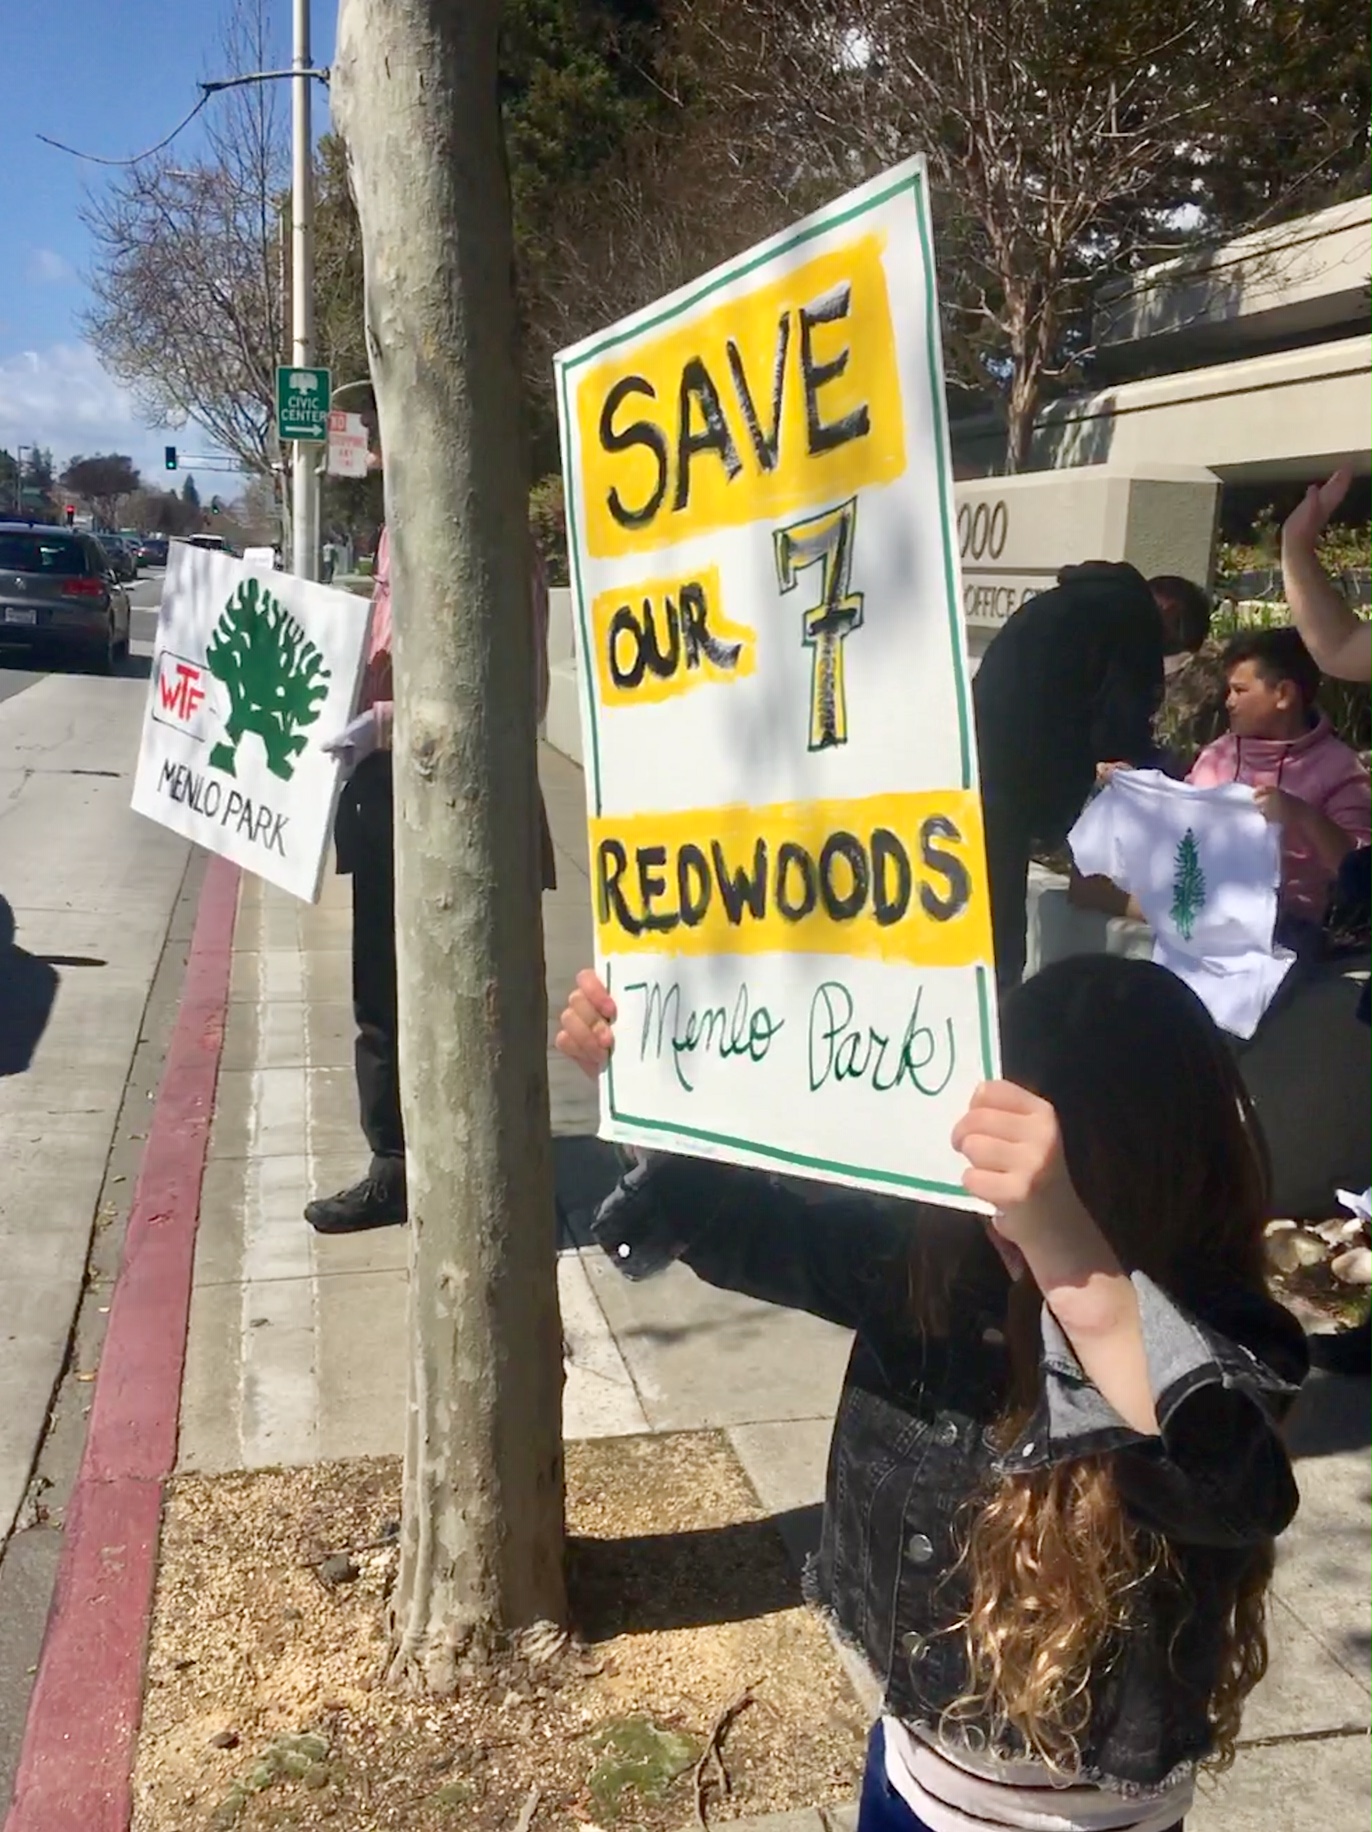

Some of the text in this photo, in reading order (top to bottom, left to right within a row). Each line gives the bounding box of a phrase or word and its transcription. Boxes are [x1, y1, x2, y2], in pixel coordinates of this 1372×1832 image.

[281, 408, 327, 422] CENTER
[288, 396, 320, 409] CIVIC
[600, 280, 870, 530] SAVE
[609, 496, 864, 752] OUR 7
[964, 584, 1016, 618] OFFICE
[160, 664, 205, 722] WTF
[157, 758, 290, 857] MENLO PARK
[598, 814, 972, 936] REDWOODS
[625, 981, 956, 1096] Menlo Park
